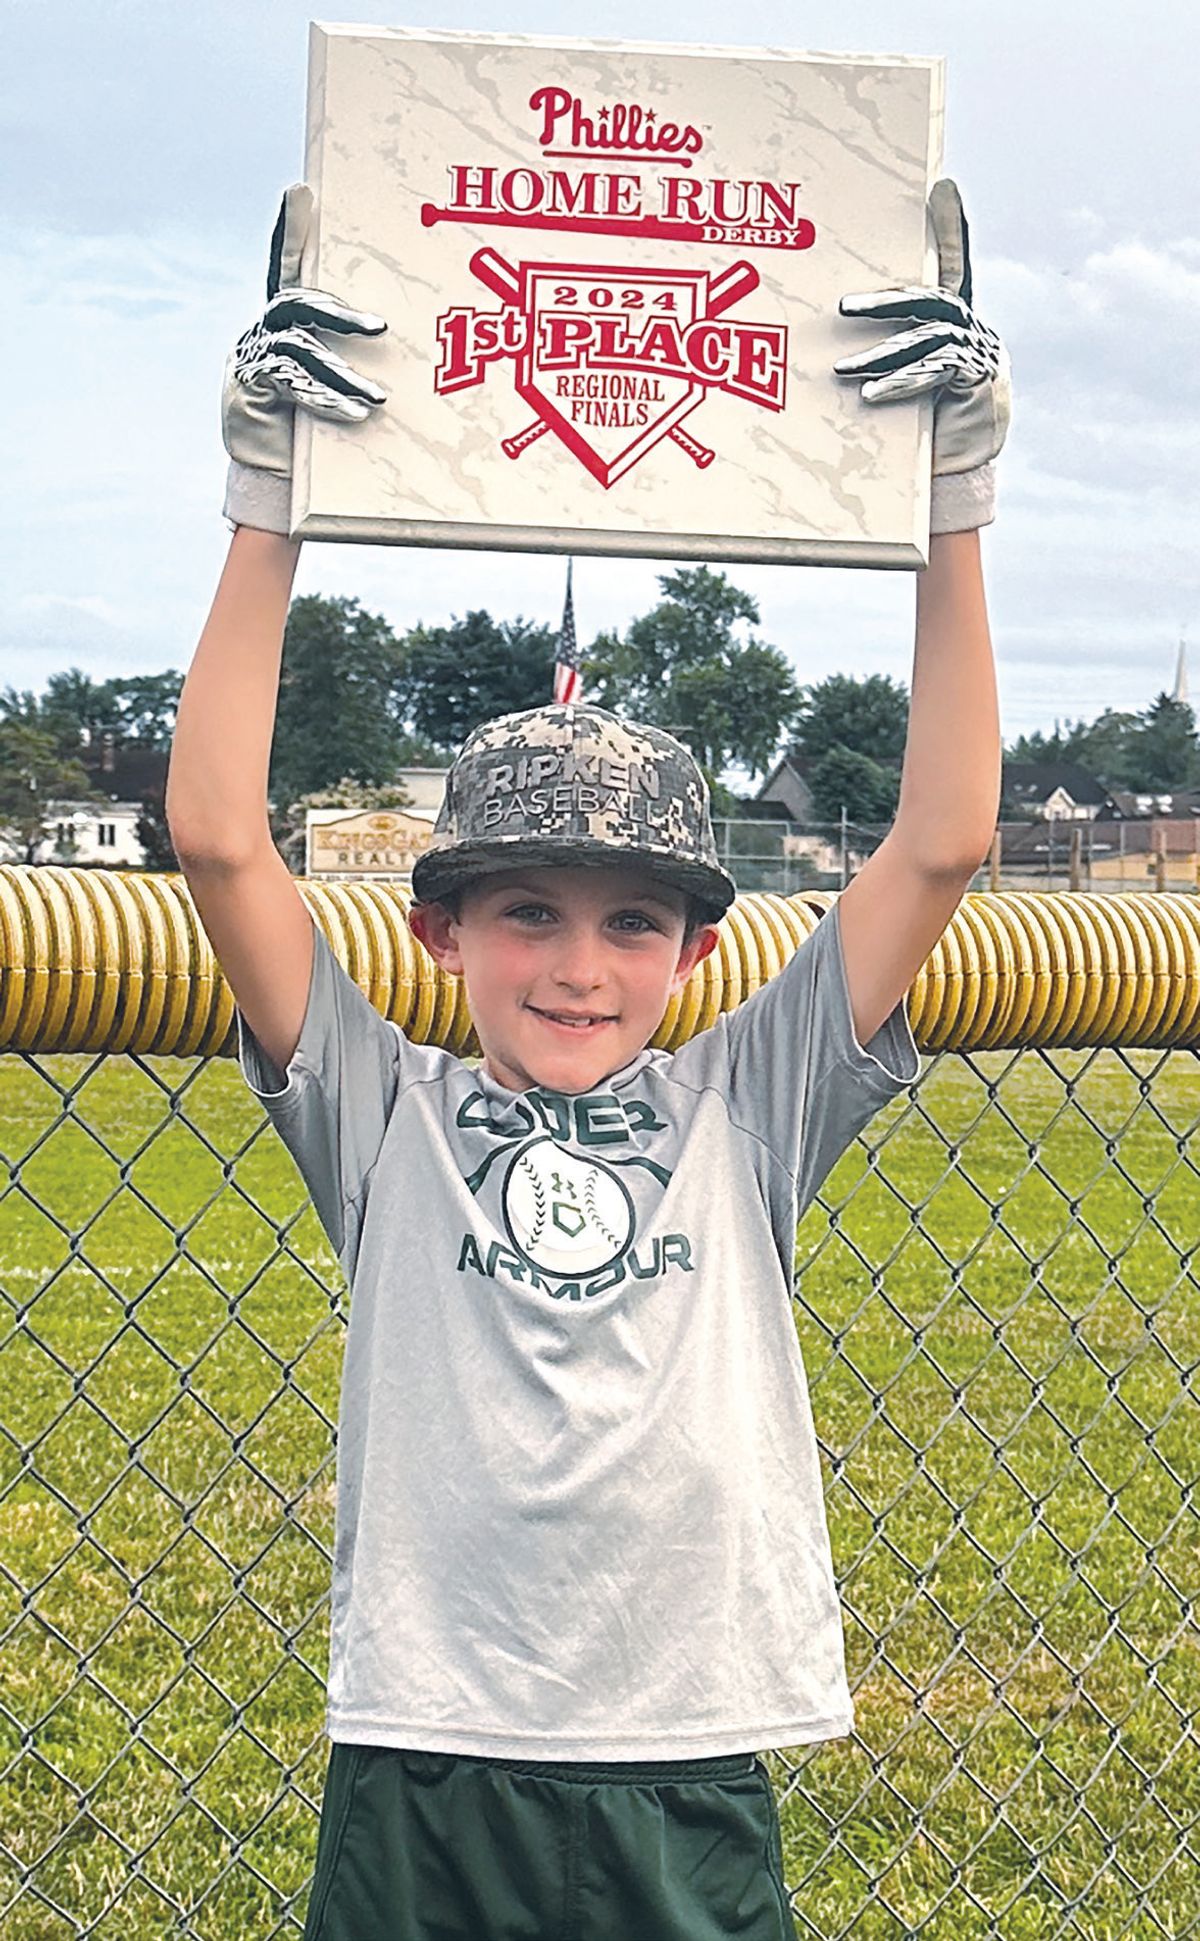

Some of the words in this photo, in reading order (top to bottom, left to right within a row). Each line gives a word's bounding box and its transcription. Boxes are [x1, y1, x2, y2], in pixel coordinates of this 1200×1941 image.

[529, 86, 703, 155] Phillies
[450, 165, 641, 217] HOME
[662, 176, 801, 226] RUN
[702, 226, 802, 247] DERBY
[554, 286, 678, 311] 2024
[444, 308, 527, 381] 1st
[545, 318, 780, 399] PLACE
[556, 374, 665, 402] REGIONAL
[571, 400, 649, 428] FINALS
[485, 755, 660, 799] RIPKEN
[483, 788, 661, 828] BASEBALL
[338, 853, 419, 865] REALT
